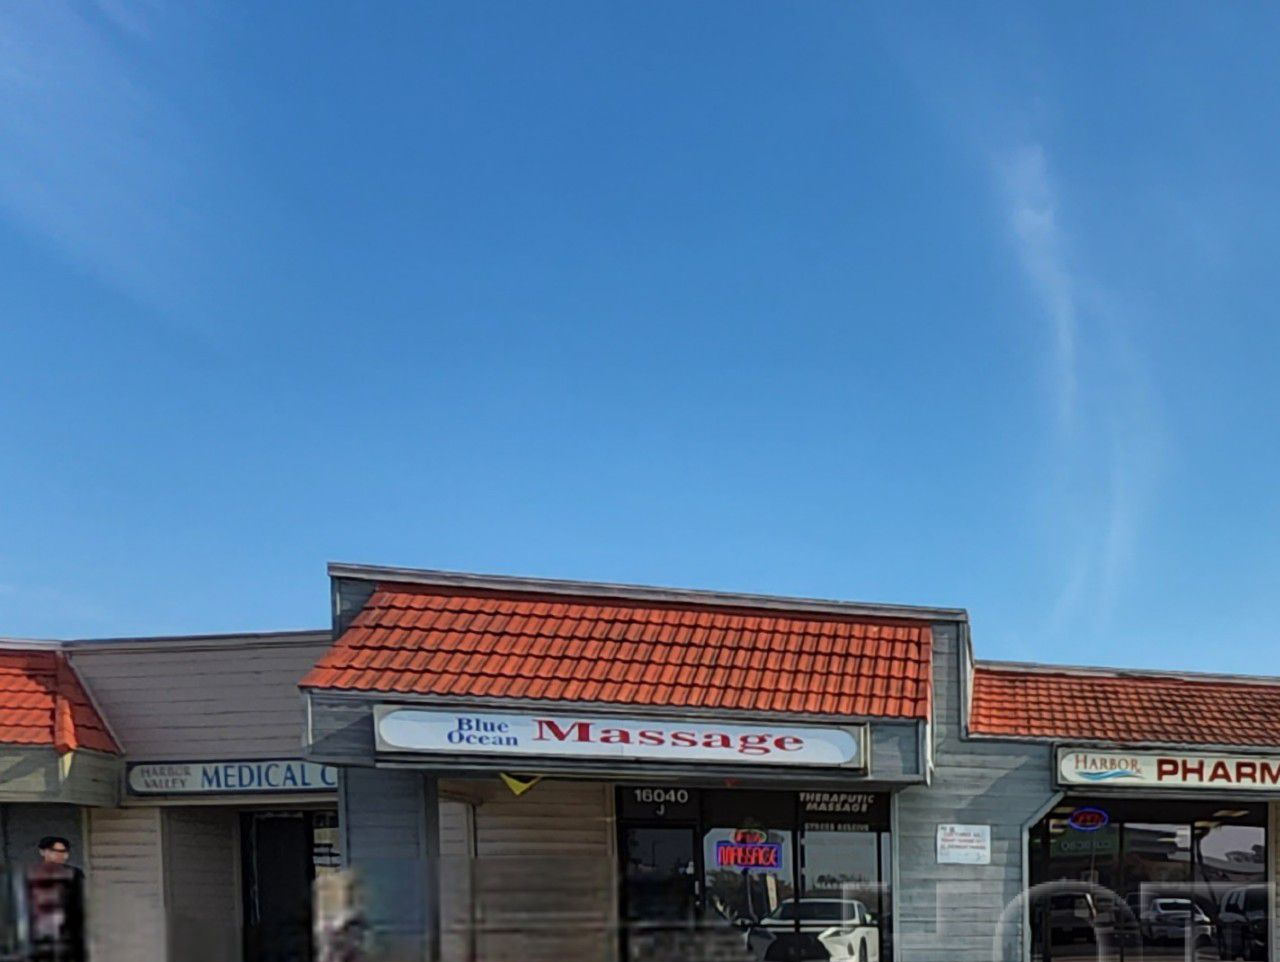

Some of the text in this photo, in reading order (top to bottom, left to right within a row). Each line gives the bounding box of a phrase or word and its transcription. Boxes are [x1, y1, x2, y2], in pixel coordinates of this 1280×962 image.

[456, 716, 510, 733] Blue
[447, 729, 519, 747] Ocean
[535, 719, 804, 755] Massage
[201, 763, 312, 789] MEDICAL
[634, 789, 689, 804] 16040
[805, 802, 868, 813] MASSAGE
